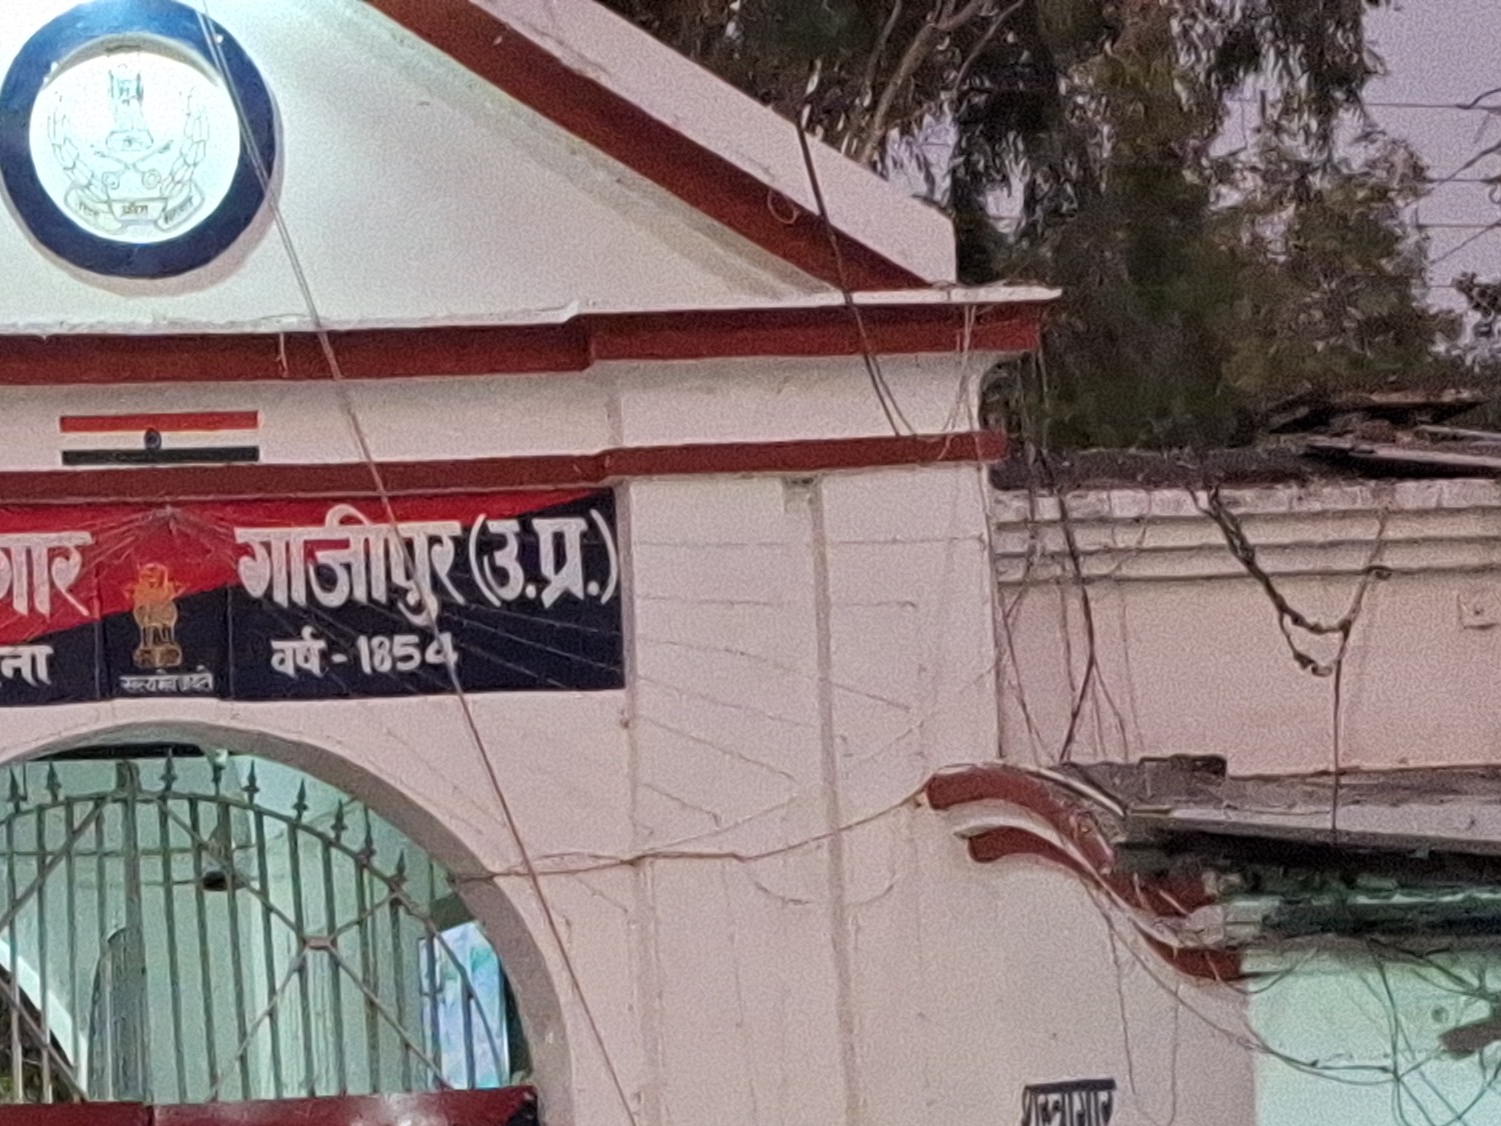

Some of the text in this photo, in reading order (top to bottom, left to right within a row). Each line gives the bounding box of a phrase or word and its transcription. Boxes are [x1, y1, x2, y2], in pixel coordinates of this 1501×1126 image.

[234, 504, 466, 627] गाजीपुर
[270, 625, 328, 678] वर्ष
[357, 632, 458, 674] 1854
